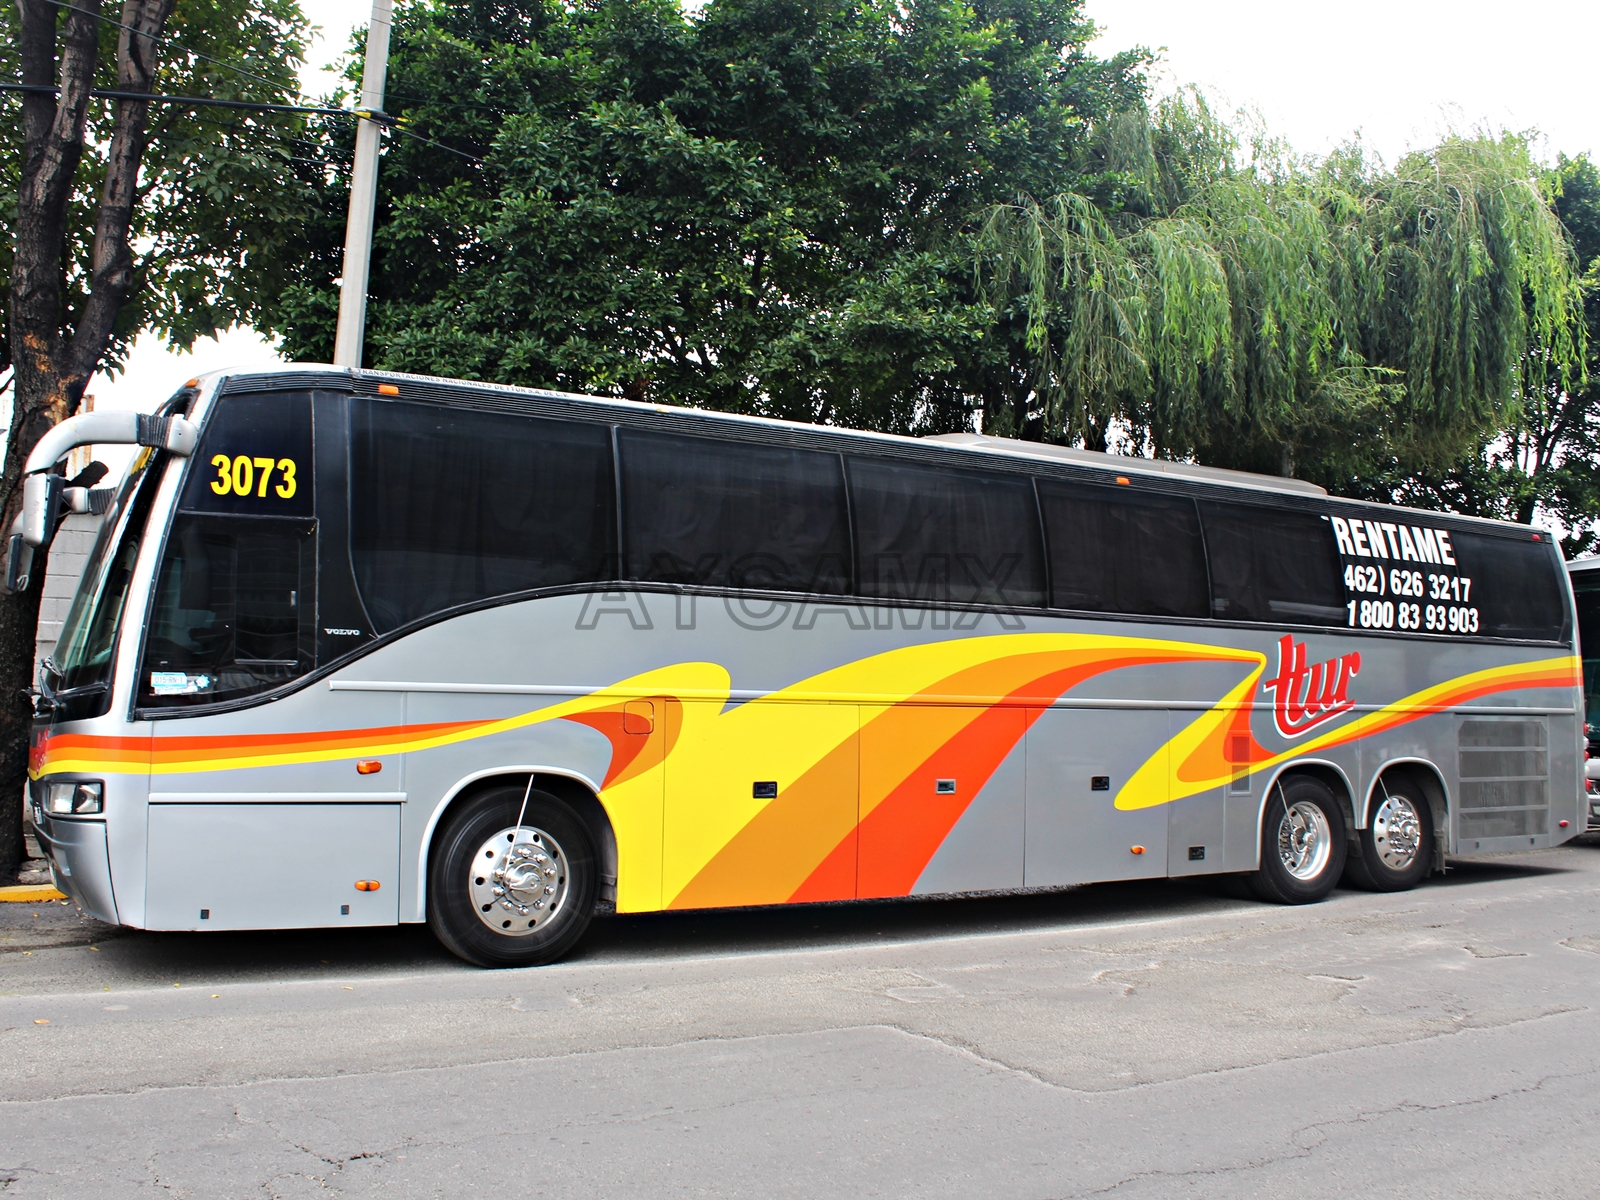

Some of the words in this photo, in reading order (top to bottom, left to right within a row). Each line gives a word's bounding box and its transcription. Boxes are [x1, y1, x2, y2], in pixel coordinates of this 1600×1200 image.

[442, 378, 492, 389] NACIONALES
[210, 453, 297, 499] 3073
[1331, 516, 1457, 566] RENTAME
[1390, 569, 1424, 597] 626
[1428, 574, 1472, 602] 3217
[1347, 600, 1357, 627] 1
[1360, 600, 1394, 629] 800
[1398, 602, 1420, 630] 83
[324, 628, 361, 636] VOLVO
